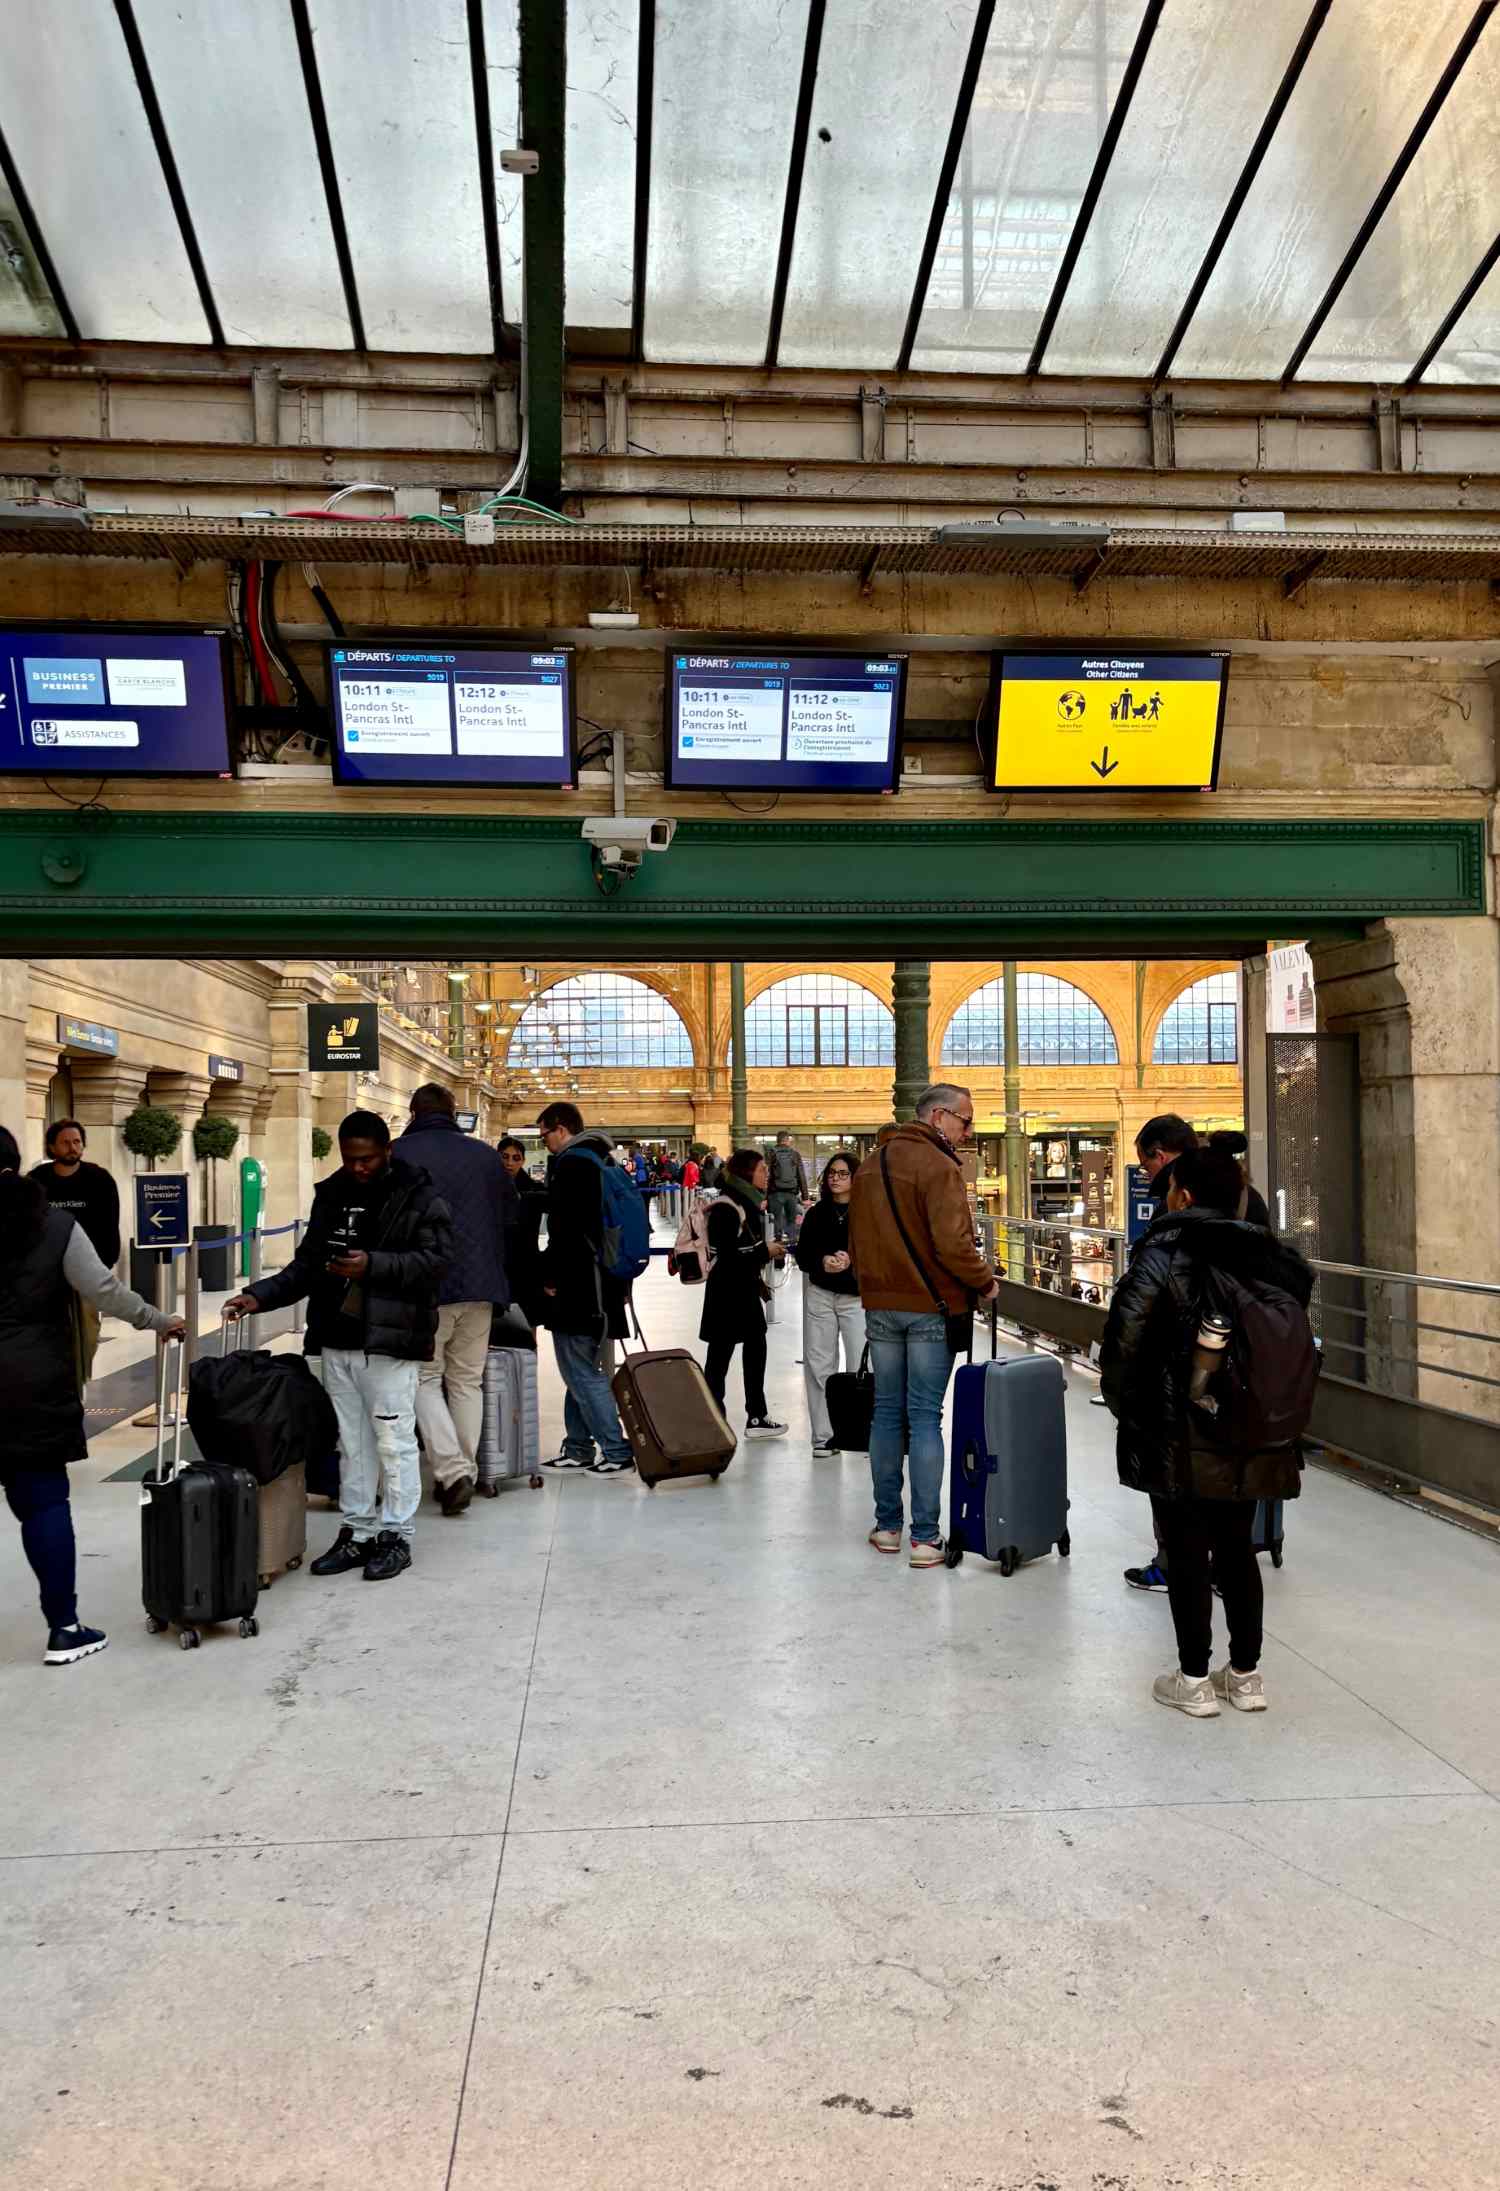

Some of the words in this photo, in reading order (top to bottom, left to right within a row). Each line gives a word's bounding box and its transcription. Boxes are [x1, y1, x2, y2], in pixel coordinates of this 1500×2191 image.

[347, 650, 391, 661] DÉPARTS
[689, 657, 729, 668] DÉPARTS
[1081, 660, 1109, 669] Autres
[1110, 660, 1145, 670] Citoyens
[32, 672, 97, 682] BUSINESS
[1086, 670, 1109, 678] Other
[1109, 670, 1139, 679] Citizens
[344, 685, 381, 695] 10:11
[459, 687, 496, 698] 12:12
[683, 691, 719, 702] 10:11
[793, 694, 829, 704] 11:12
[344, 701, 388, 711] London
[391, 702, 409, 712] St-
[459, 703, 502, 714] London
[505, 704, 523, 714] St-
[682, 706, 724, 718] London
[727, 708, 745, 718] St-
[345, 713, 390, 724] Pancras
[393, 715, 414, 725] Intl
[459, 715, 504, 726] Pancras
[506, 717, 527, 727] Intl
[791, 710, 833, 720] London
[835, 711, 853, 721] St-
[682, 719, 725, 730] Pancras
[728, 721, 748, 730] Intl
[791, 722, 833, 732] Pancras
[836, 723, 856, 733] Intl
[64, 730, 126, 739] ASSISTANCES
[143, 1184, 181, 1192] Business
[144, 1191, 180, 1199] Premier
